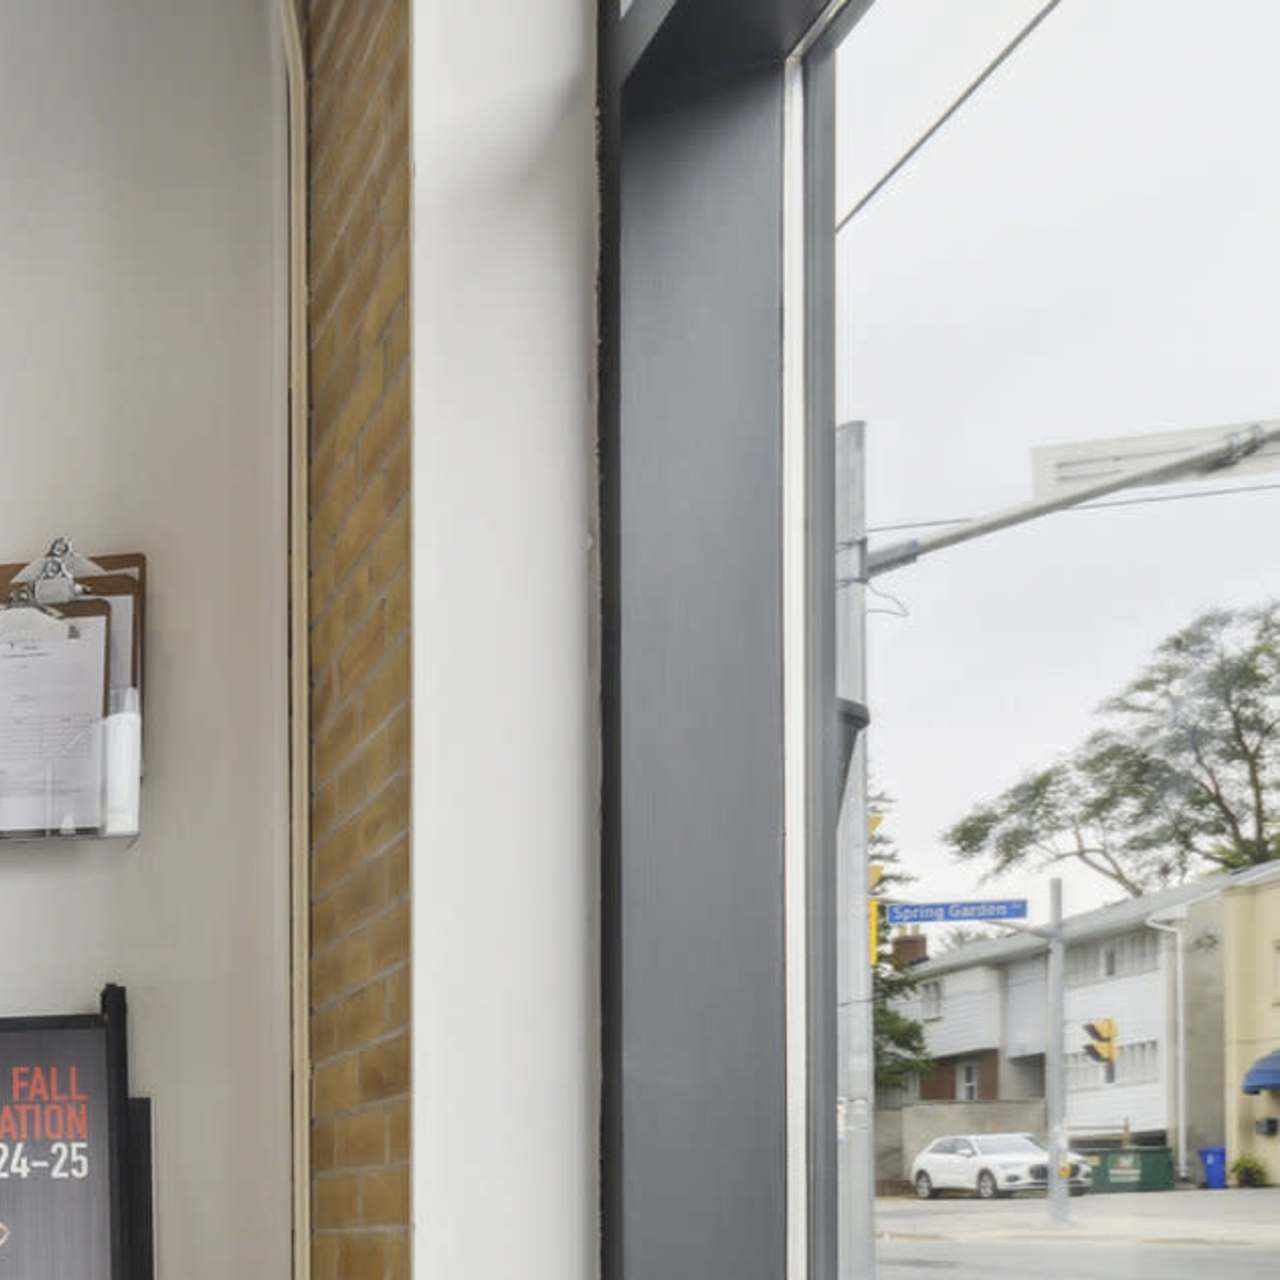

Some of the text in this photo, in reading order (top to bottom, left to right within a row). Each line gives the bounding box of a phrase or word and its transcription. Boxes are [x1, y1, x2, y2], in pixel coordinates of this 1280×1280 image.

[892, 904, 944, 921] Spring
[947, 903, 1008, 919] Garden
[10, 1065, 89, 1102] FALL
